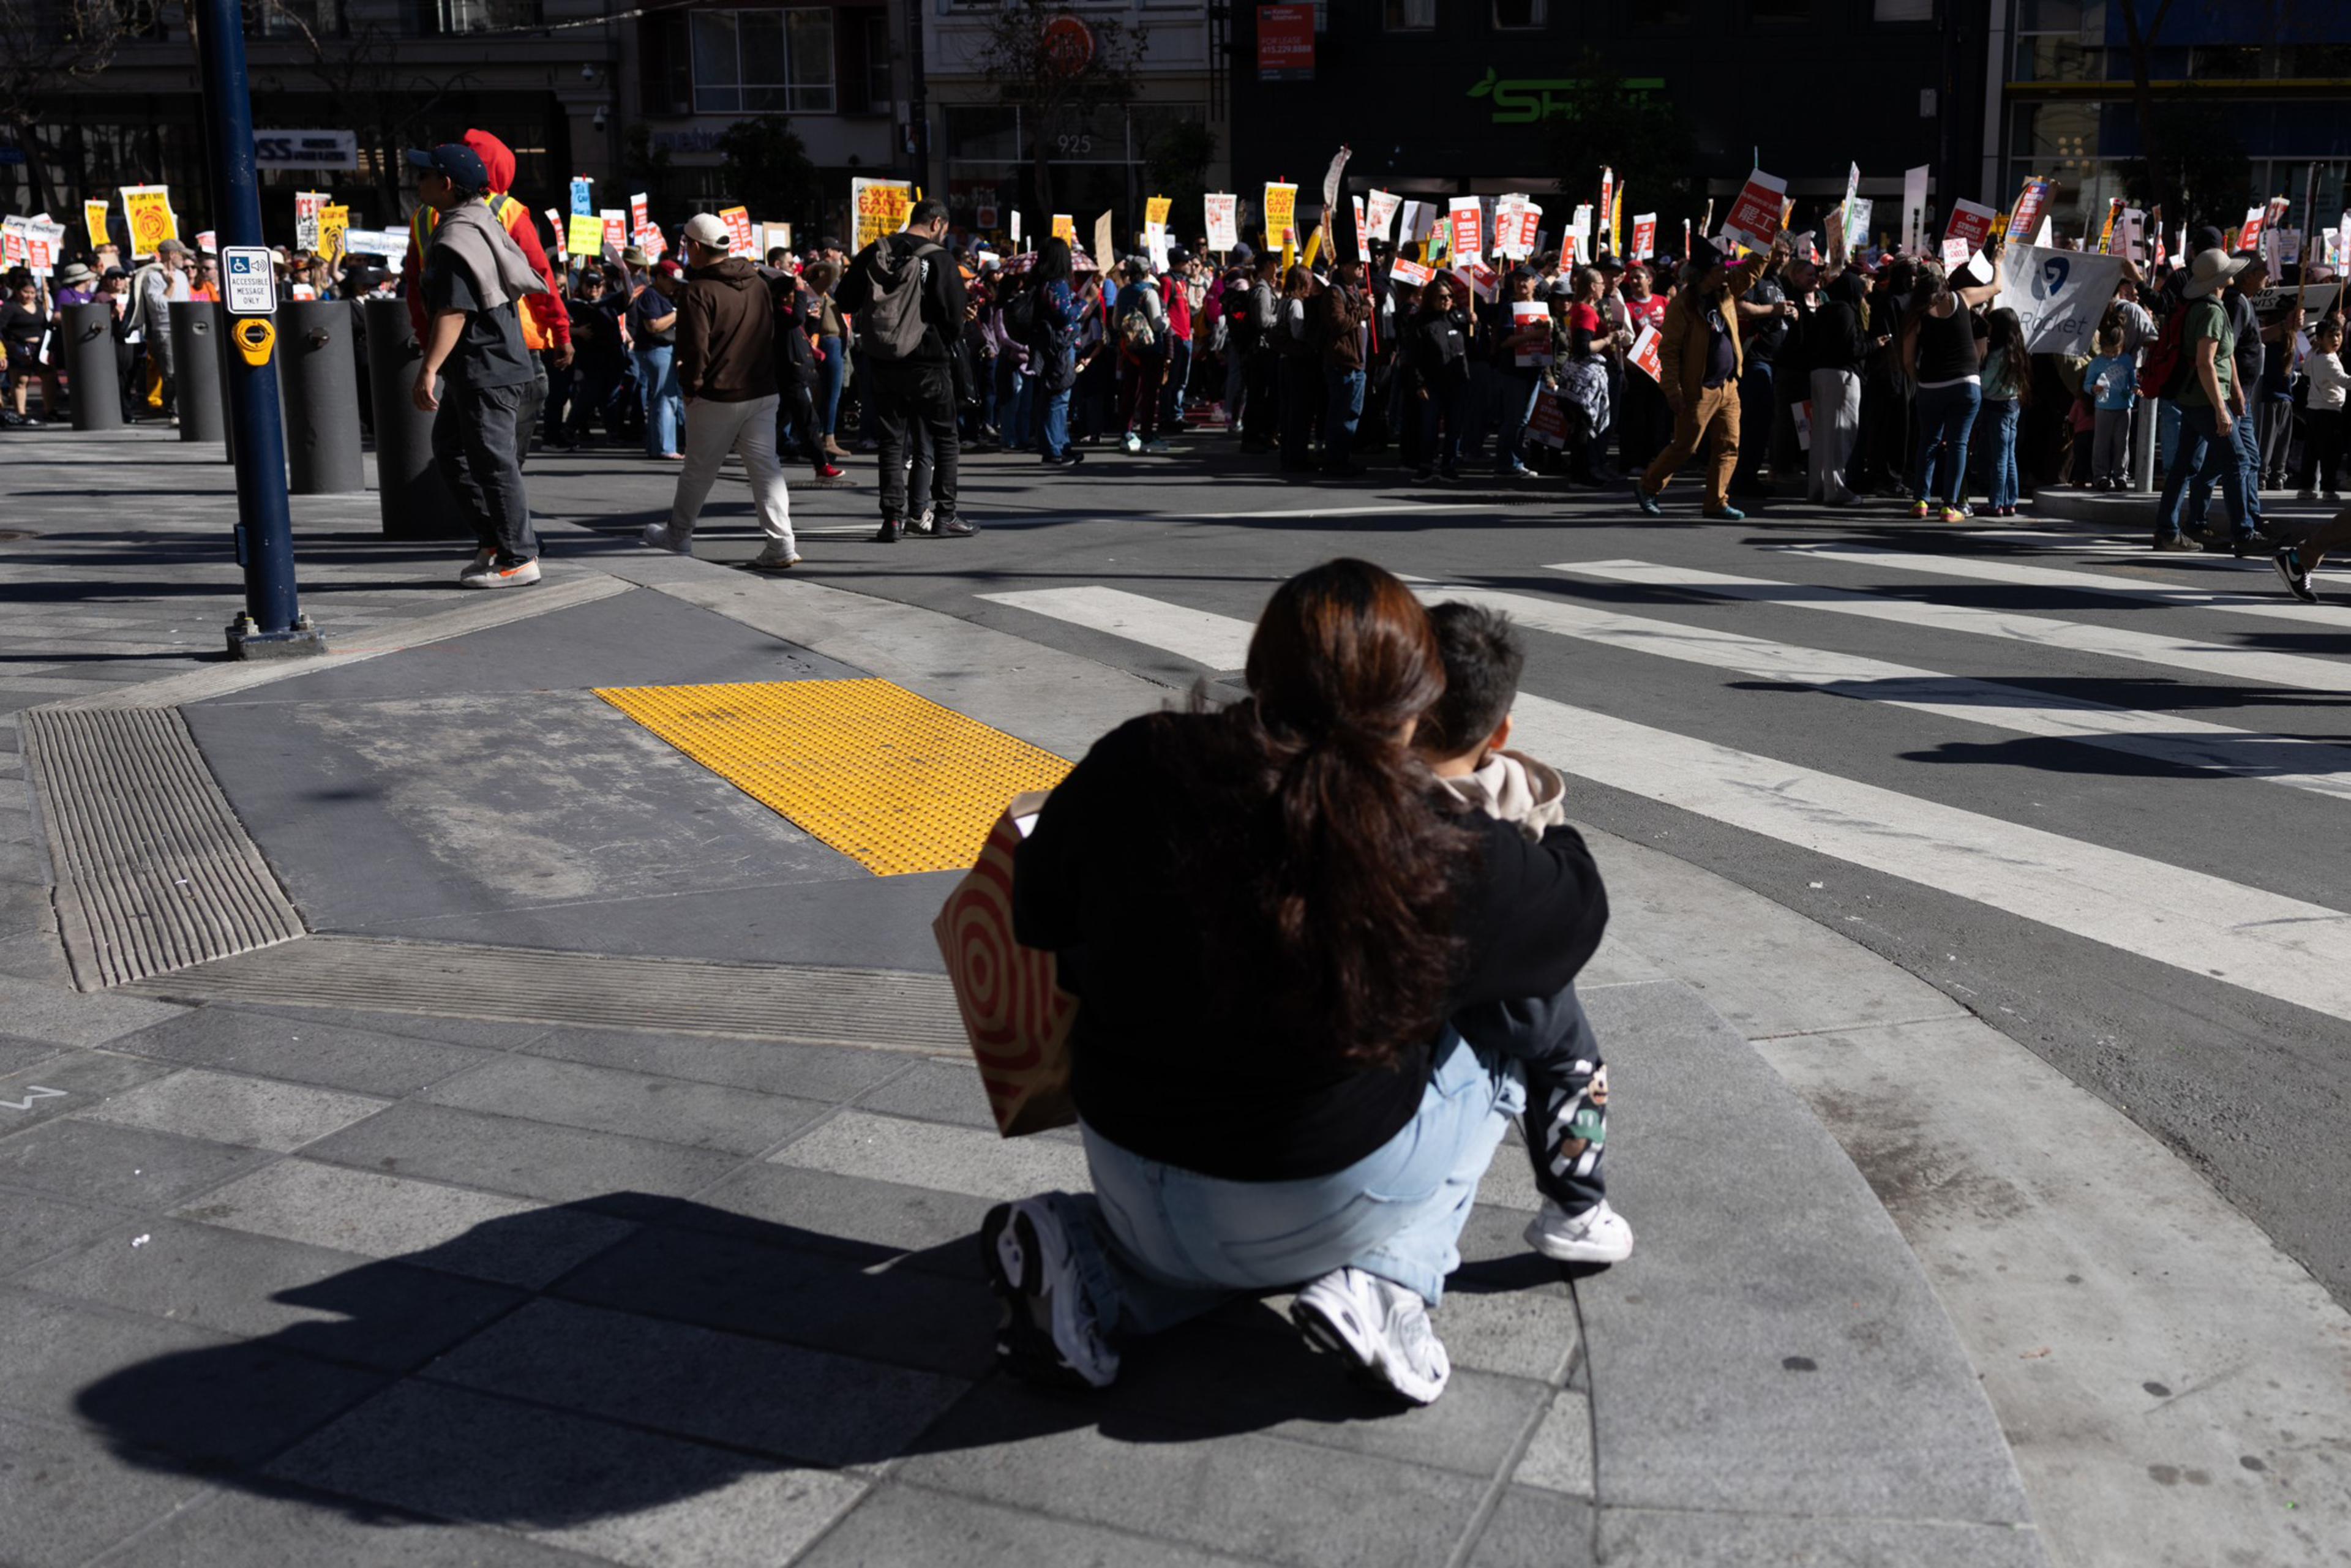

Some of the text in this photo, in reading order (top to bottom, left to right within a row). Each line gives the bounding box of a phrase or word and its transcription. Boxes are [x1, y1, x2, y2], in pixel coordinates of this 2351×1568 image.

[1057, 134, 1091, 154] 925
[869, 189, 896, 199] WE
[860, 205, 903, 217] WAIT
[1461, 211, 1472, 220] ON
[1738, 203, 1777, 233] 罷工
[1966, 214, 1979, 223] ON
[1457, 221, 1477, 230] STRIKE
[1956, 221, 1982, 234] STRIKE
[2020, 312, 2088, 336] Rocket
[1644, 342, 1655, 356] ON
